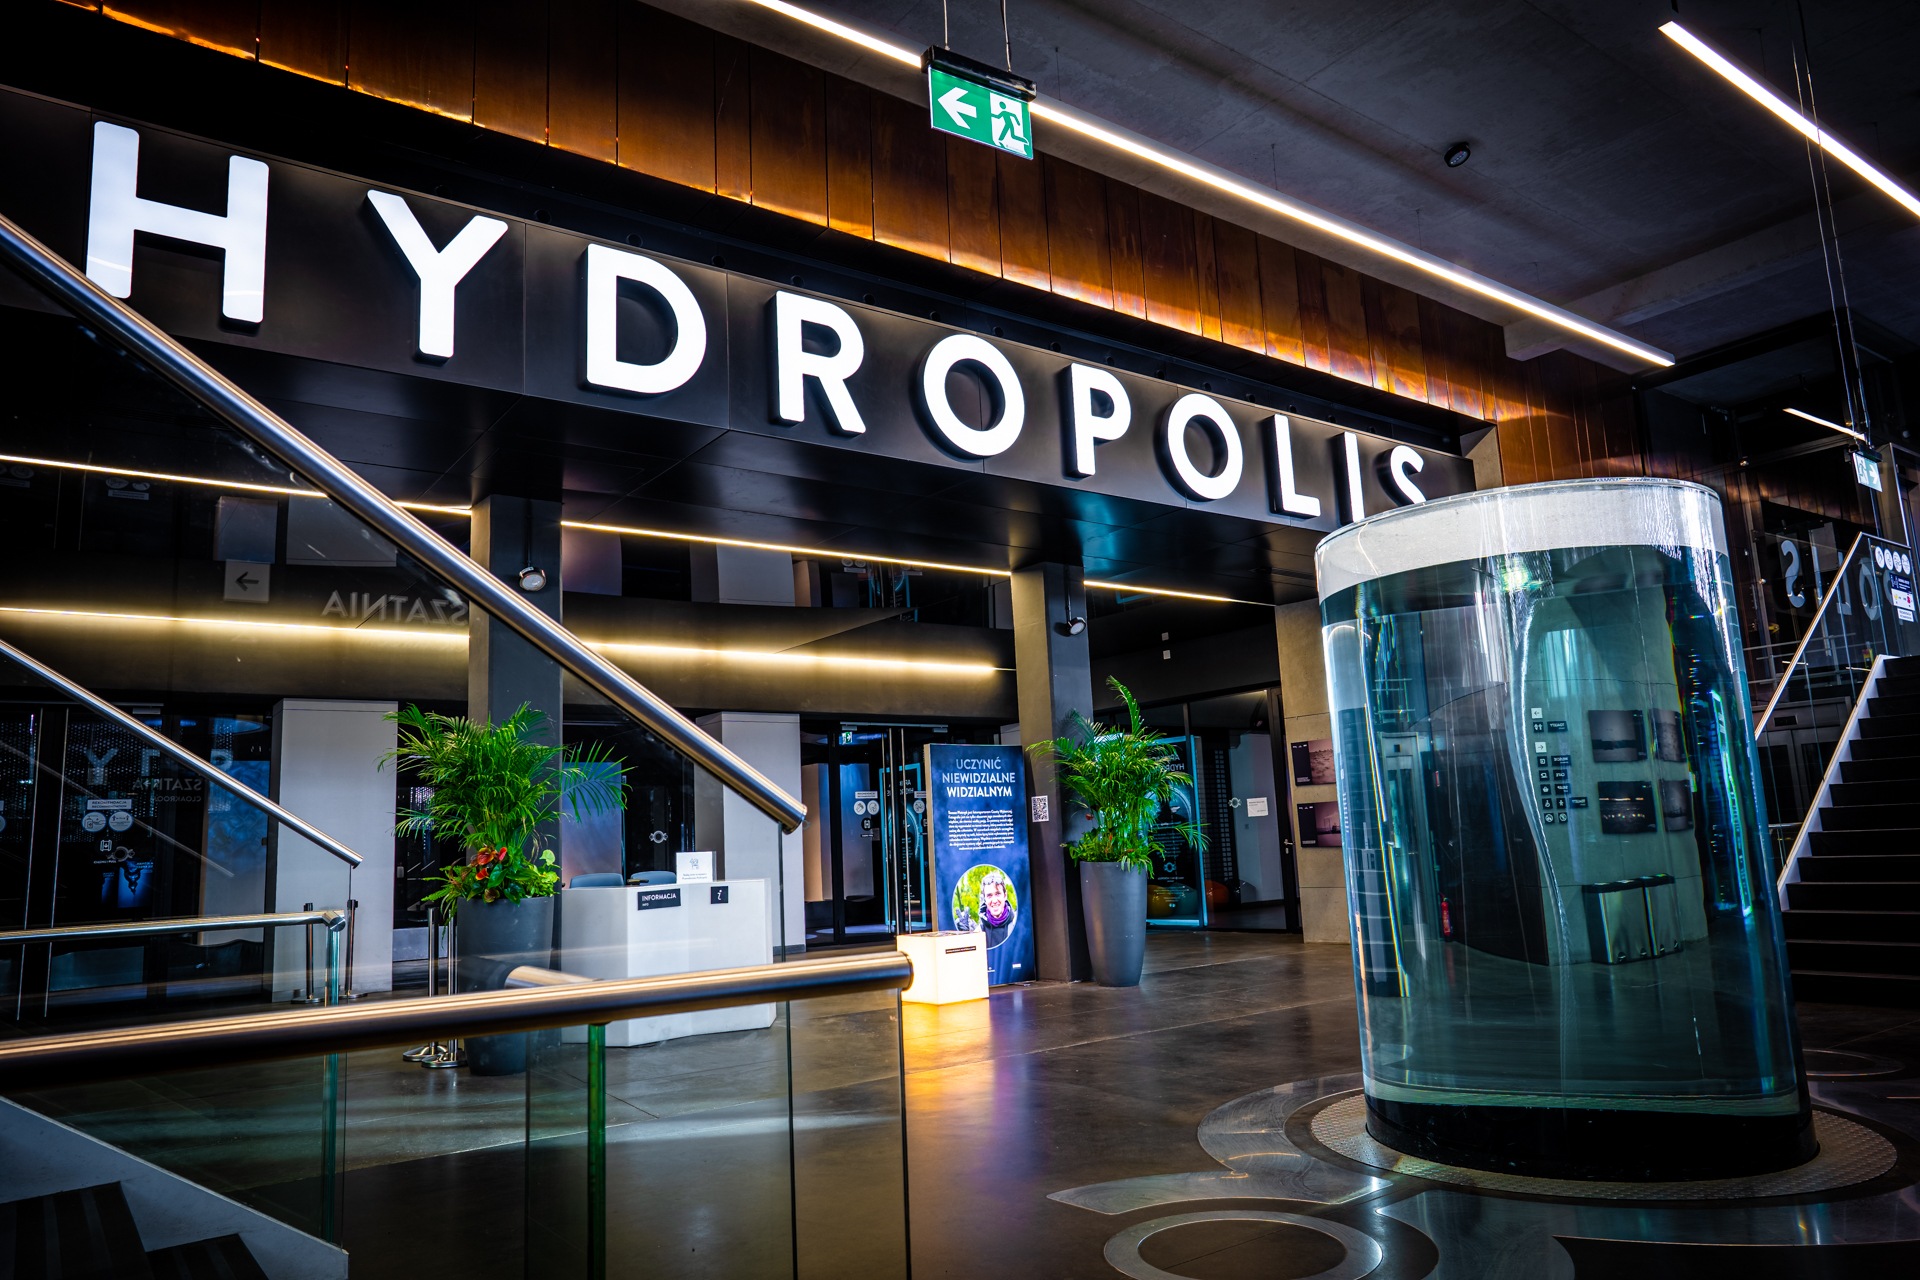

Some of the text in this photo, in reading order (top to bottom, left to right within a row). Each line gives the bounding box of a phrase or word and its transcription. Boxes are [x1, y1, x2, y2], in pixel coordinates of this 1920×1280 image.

[85, 121, 1426, 523] HYDROPOLIS
[955, 756, 1002, 770] UCZYNIĆ
[942, 772, 1016, 783] NIEWIDZIALNE
[946, 786, 1012, 798] WIDZIALNYM
[641, 893, 677, 902] INFORMACJA
